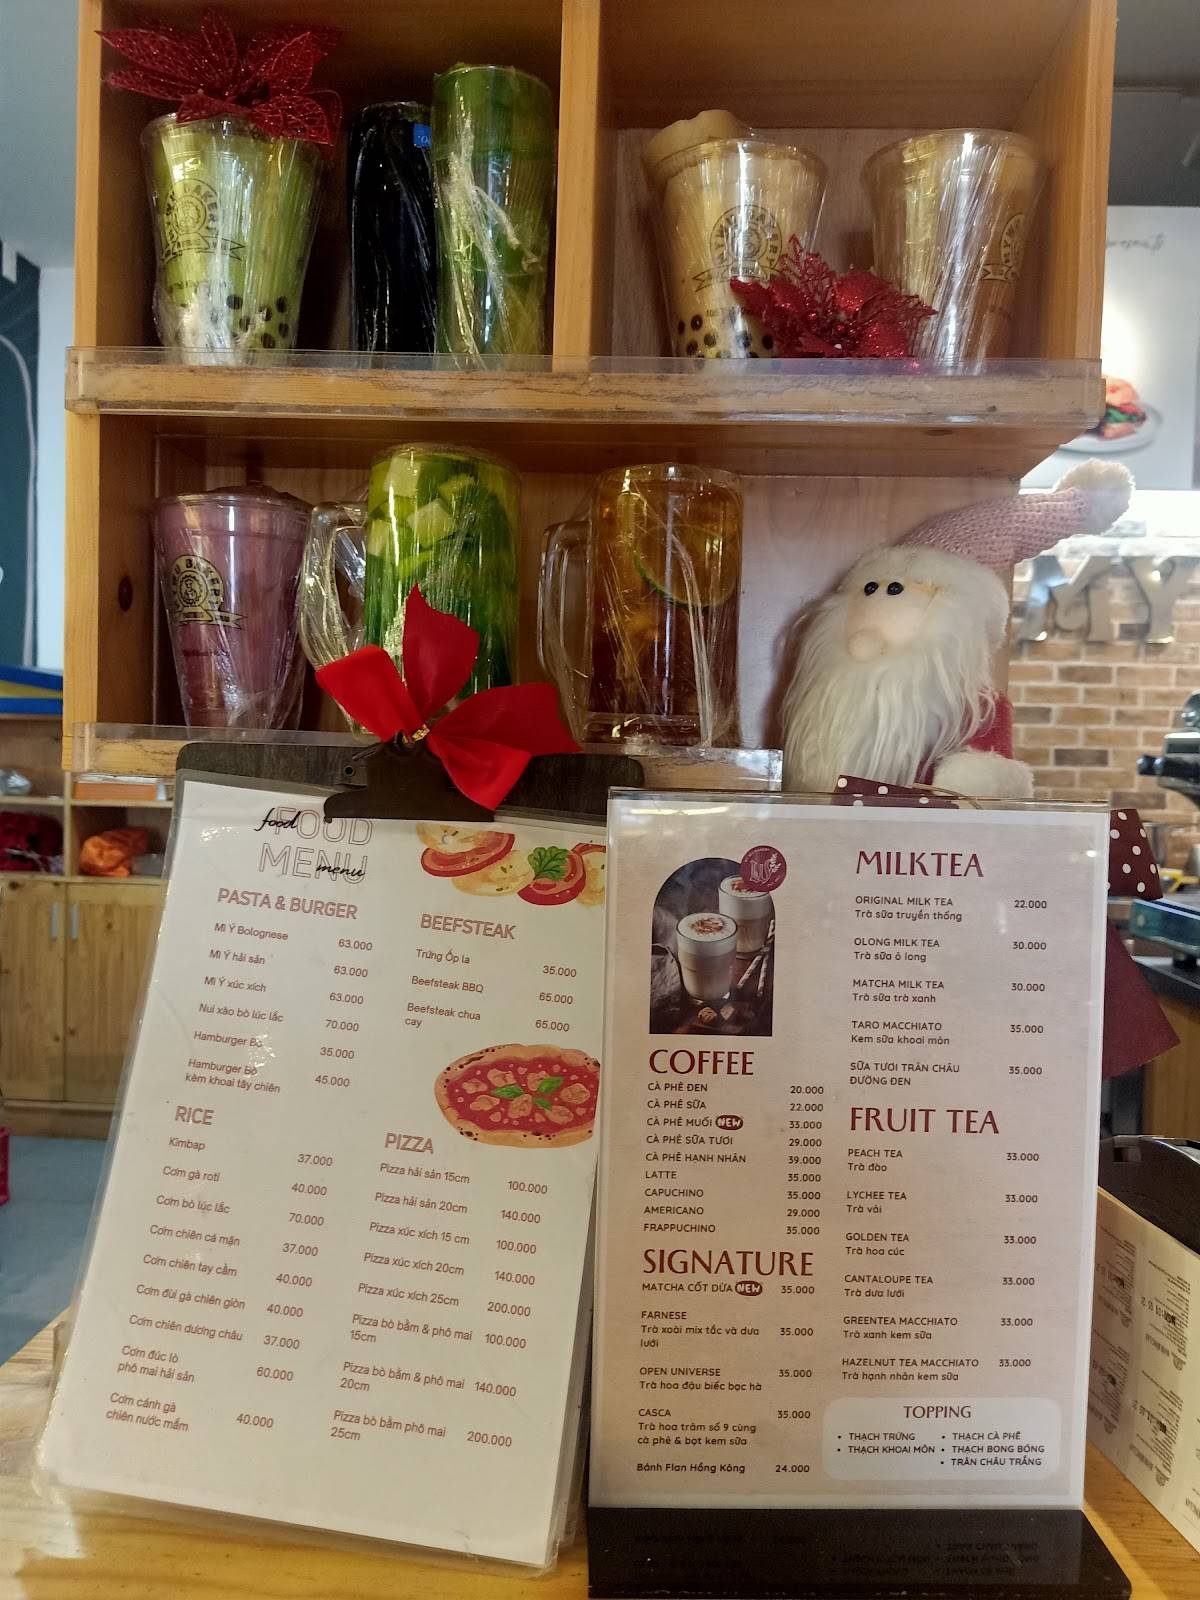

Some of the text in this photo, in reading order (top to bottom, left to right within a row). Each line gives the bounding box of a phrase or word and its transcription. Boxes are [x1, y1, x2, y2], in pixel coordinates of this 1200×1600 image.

[259, 843, 368, 884] MENU
[316, 864, 365, 876] menu
[218, 888, 358, 919] PASTA & BURGER
[855, 896, 953, 906] ORIGINAL MILK TEA
[1014, 900, 1047, 909] 22.000
[421, 914, 516, 939] BEEFSTEAK
[237, 926, 288, 940] Bolognese
[338, 939, 372, 951] 63.000
[854, 938, 940, 947] OLONG MILK TEA
[1013, 942, 1046, 950] 30.000
[462, 954, 470, 964] la
[904, 952, 926, 963] long
[334, 966, 368, 977] 63.000
[543, 966, 576, 977] 35.000
[412, 976, 484, 993] Beefsteak BBQ
[853, 979, 944, 989] MATCHA MILK TEA
[1011, 983, 1045, 992] 30.000
[330, 993, 364, 1005] 63.000
[539, 992, 573, 1004] 65.000
[912, 995, 936, 1003] xanh
[407, 1003, 481, 1020] Beefsteak chua
[325, 1020, 359, 1031] 70.000
[405, 1018, 422, 1028] cay
[536, 1020, 569, 1032] 65.000
[852, 1021, 942, 1030] TARO MACCHIATO
[1010, 1025, 1044, 1034] 35.000
[194, 1031, 246, 1046] Hamburger
[851, 1035, 924, 1044] Kem khoai
[320, 1048, 354, 1059] 35.000
[189, 1059, 241, 1074] Hamburger
[650, 1050, 754, 1075] COFFEE
[1009, 1067, 1042, 1075] 35.000
[315, 1075, 350, 1087] 45.000
[648, 1081, 661, 1091] CÀ
[790, 1086, 824, 1094] 20.000
[790, 1103, 823, 1112] 22.000
[175, 1106, 214, 1125] RICE
[850, 1107, 1000, 1134] FRUIT TEA
[717, 1118, 742, 1127] NEW
[789, 1121, 822, 1129] 33.000
[169, 1137, 205, 1151] Kimbap
[385, 1133, 434, 1154] PIZZA
[789, 1138, 822, 1147] 29.000
[884, 1150, 903, 1158] TEA
[1006, 1153, 1039, 1161] 33.000
[298, 1154, 333, 1167] 37.000
[788, 1156, 821, 1165] 39.000
[380, 1163, 470, 1184] Pizza 15cm
[645, 1171, 677, 1179] LATTE
[788, 1174, 821, 1182] 35.000
[291, 1183, 327, 1196] 40.000
[508, 1181, 548, 1194] 100.000
[645, 1189, 704, 1197] CAPUCHINO
[787, 1191, 820, 1200] 35.000
[847, 1191, 907, 1200] LYCHEE TEA
[375, 1192, 468, 1214] Pizza 20cm
[1005, 1195, 1038, 1203] 33.000
[644, 1206, 704, 1215] AMERICANO
[787, 1209, 820, 1217] 29.000
[289, 1213, 324, 1226] 70.000
[501, 1210, 541, 1223] 140.000
[370, 1222, 395, 1234] Pizza
[644, 1224, 715, 1233] FRAPPUCHINO
[786, 1227, 820, 1235] 35.000
[846, 1233, 909, 1242] GOLDEN TEA
[1004, 1236, 1036, 1244] 33.000
[282, 1243, 318, 1256] 37.000
[496, 1240, 536, 1254] 100.000
[866, 1247, 885, 1255] hoa
[364, 1252, 464, 1275] Pizza 20cm
[644, 1249, 813, 1276] SIGNATURE
[276, 1274, 312, 1287] 40.000
[495, 1271, 535, 1285] 140.000
[844, 1275, 933, 1284] CANTALOUPE TEA
[1002, 1277, 1035, 1285] 33.000
[642, 1283, 760, 1293] MATCHA NEW
[781, 1286, 815, 1294] 35.000
[358, 1283, 459, 1306] Pizza 25cm
[267, 1304, 303, 1318] 40.000
[488, 1301, 531, 1317] 200.000
[641, 1311, 687, 1319] FARNESE
[843, 1317, 958, 1325] GREENTEA MACCHIATO
[1000, 1318, 1033, 1326] 33.000
[352, 1314, 472, 1340] Pizza & mai
[686, 1326, 703, 1334] mix
[780, 1328, 813, 1336] 35.000
[350, 1330, 376, 1343] 15cm
[864, 1331, 911, 1339] xanh kem
[264, 1335, 300, 1349] 37.000
[485, 1334, 526, 1349] 100.000
[842, 1358, 979, 1367] HAZELNUT TEA MACCHIATO
[999, 1359, 1031, 1367] 33.000
[256, 1367, 293, 1381] 60.000
[344, 1362, 464, 1389] Pizza & mai
[640, 1368, 721, 1376] OPEN UNIVERSE
[779, 1369, 812, 1377] 35.000
[918, 1373, 938, 1381] kem
[340, 1378, 370, 1391] 20cm
[475, 1382, 516, 1397] 140.000
[661, 1382, 678, 1390] hoa
[639, 1409, 671, 1417] CASCA
[778, 1410, 811, 1419] 35.000
[904, 1406, 972, 1418] TOPPING
[236, 1413, 273, 1428] 40.000
[334, 1410, 446, 1437] Pizza mai
[659, 1423, 728, 1432] hoa 9
[331, 1427, 360, 1441] 25cm
[467, 1431, 512, 1447] 200.000
[675, 1437, 726, 1445] & kem
[882, 1446, 911, 1454] KHOAI
[987, 1445, 1014, 1454] BONG
[666, 1463, 687, 1472] Flan
[776, 1465, 810, 1473] 24.000
